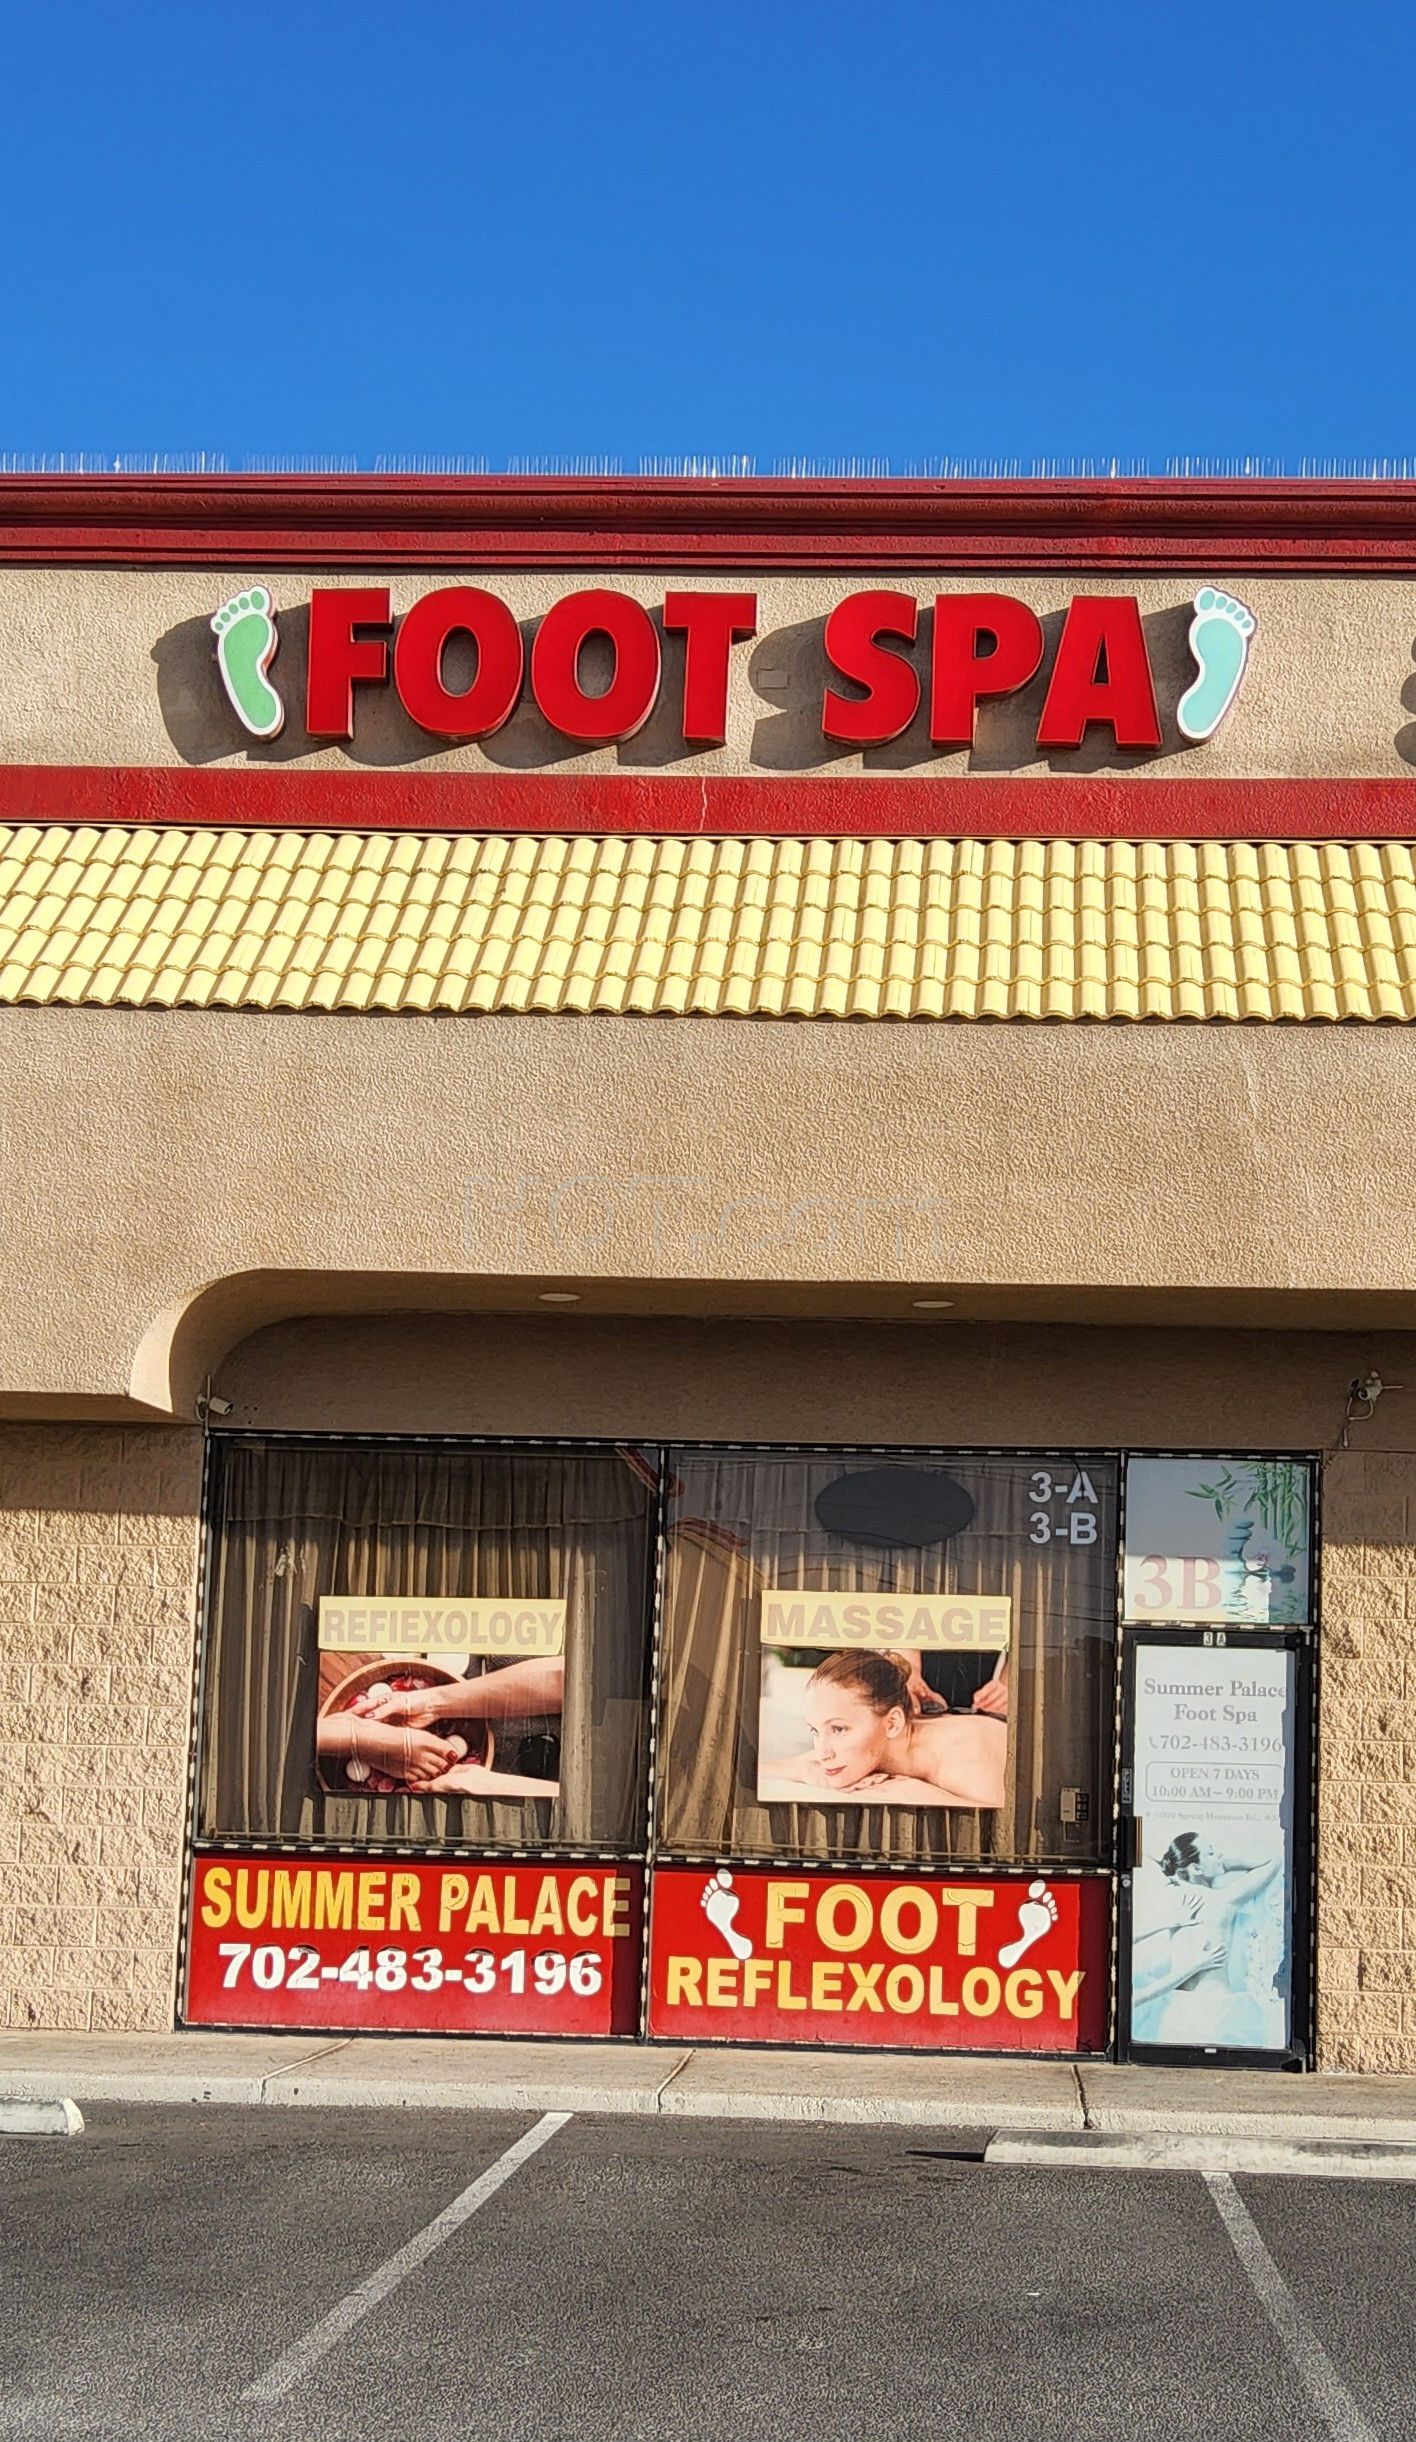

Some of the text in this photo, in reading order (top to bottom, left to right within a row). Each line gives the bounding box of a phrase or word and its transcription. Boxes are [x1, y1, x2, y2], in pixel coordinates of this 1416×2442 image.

[304, 586, 1164, 750] FOOT SPA
[1028, 1471, 1099, 1504] 3-A
[1029, 1512, 1098, 1545] 3-B
[1134, 1554, 1222, 1610] 3B
[767, 1603, 1007, 1643] MASSAGE
[1144, 1678, 1286, 1698] Summer Palace
[1173, 1703, 1258, 1724] Foot Spa
[1160, 1735, 1282, 1753] 702-483-3196
[1170, 1767, 1260, 1780] OPEN 7 DAYS
[1152, 1786, 1186, 1797] 10:00
[1226, 1788, 1253, 1799] 9:00
[1257, 1788, 1279, 1799] PM
[201, 1867, 631, 1937] SUMMER PALACE
[765, 1882, 995, 1956] FOOT
[218, 1943, 602, 1996] 702-483-3196
[666, 1955, 1086, 2020] REFLEXOLOGY
